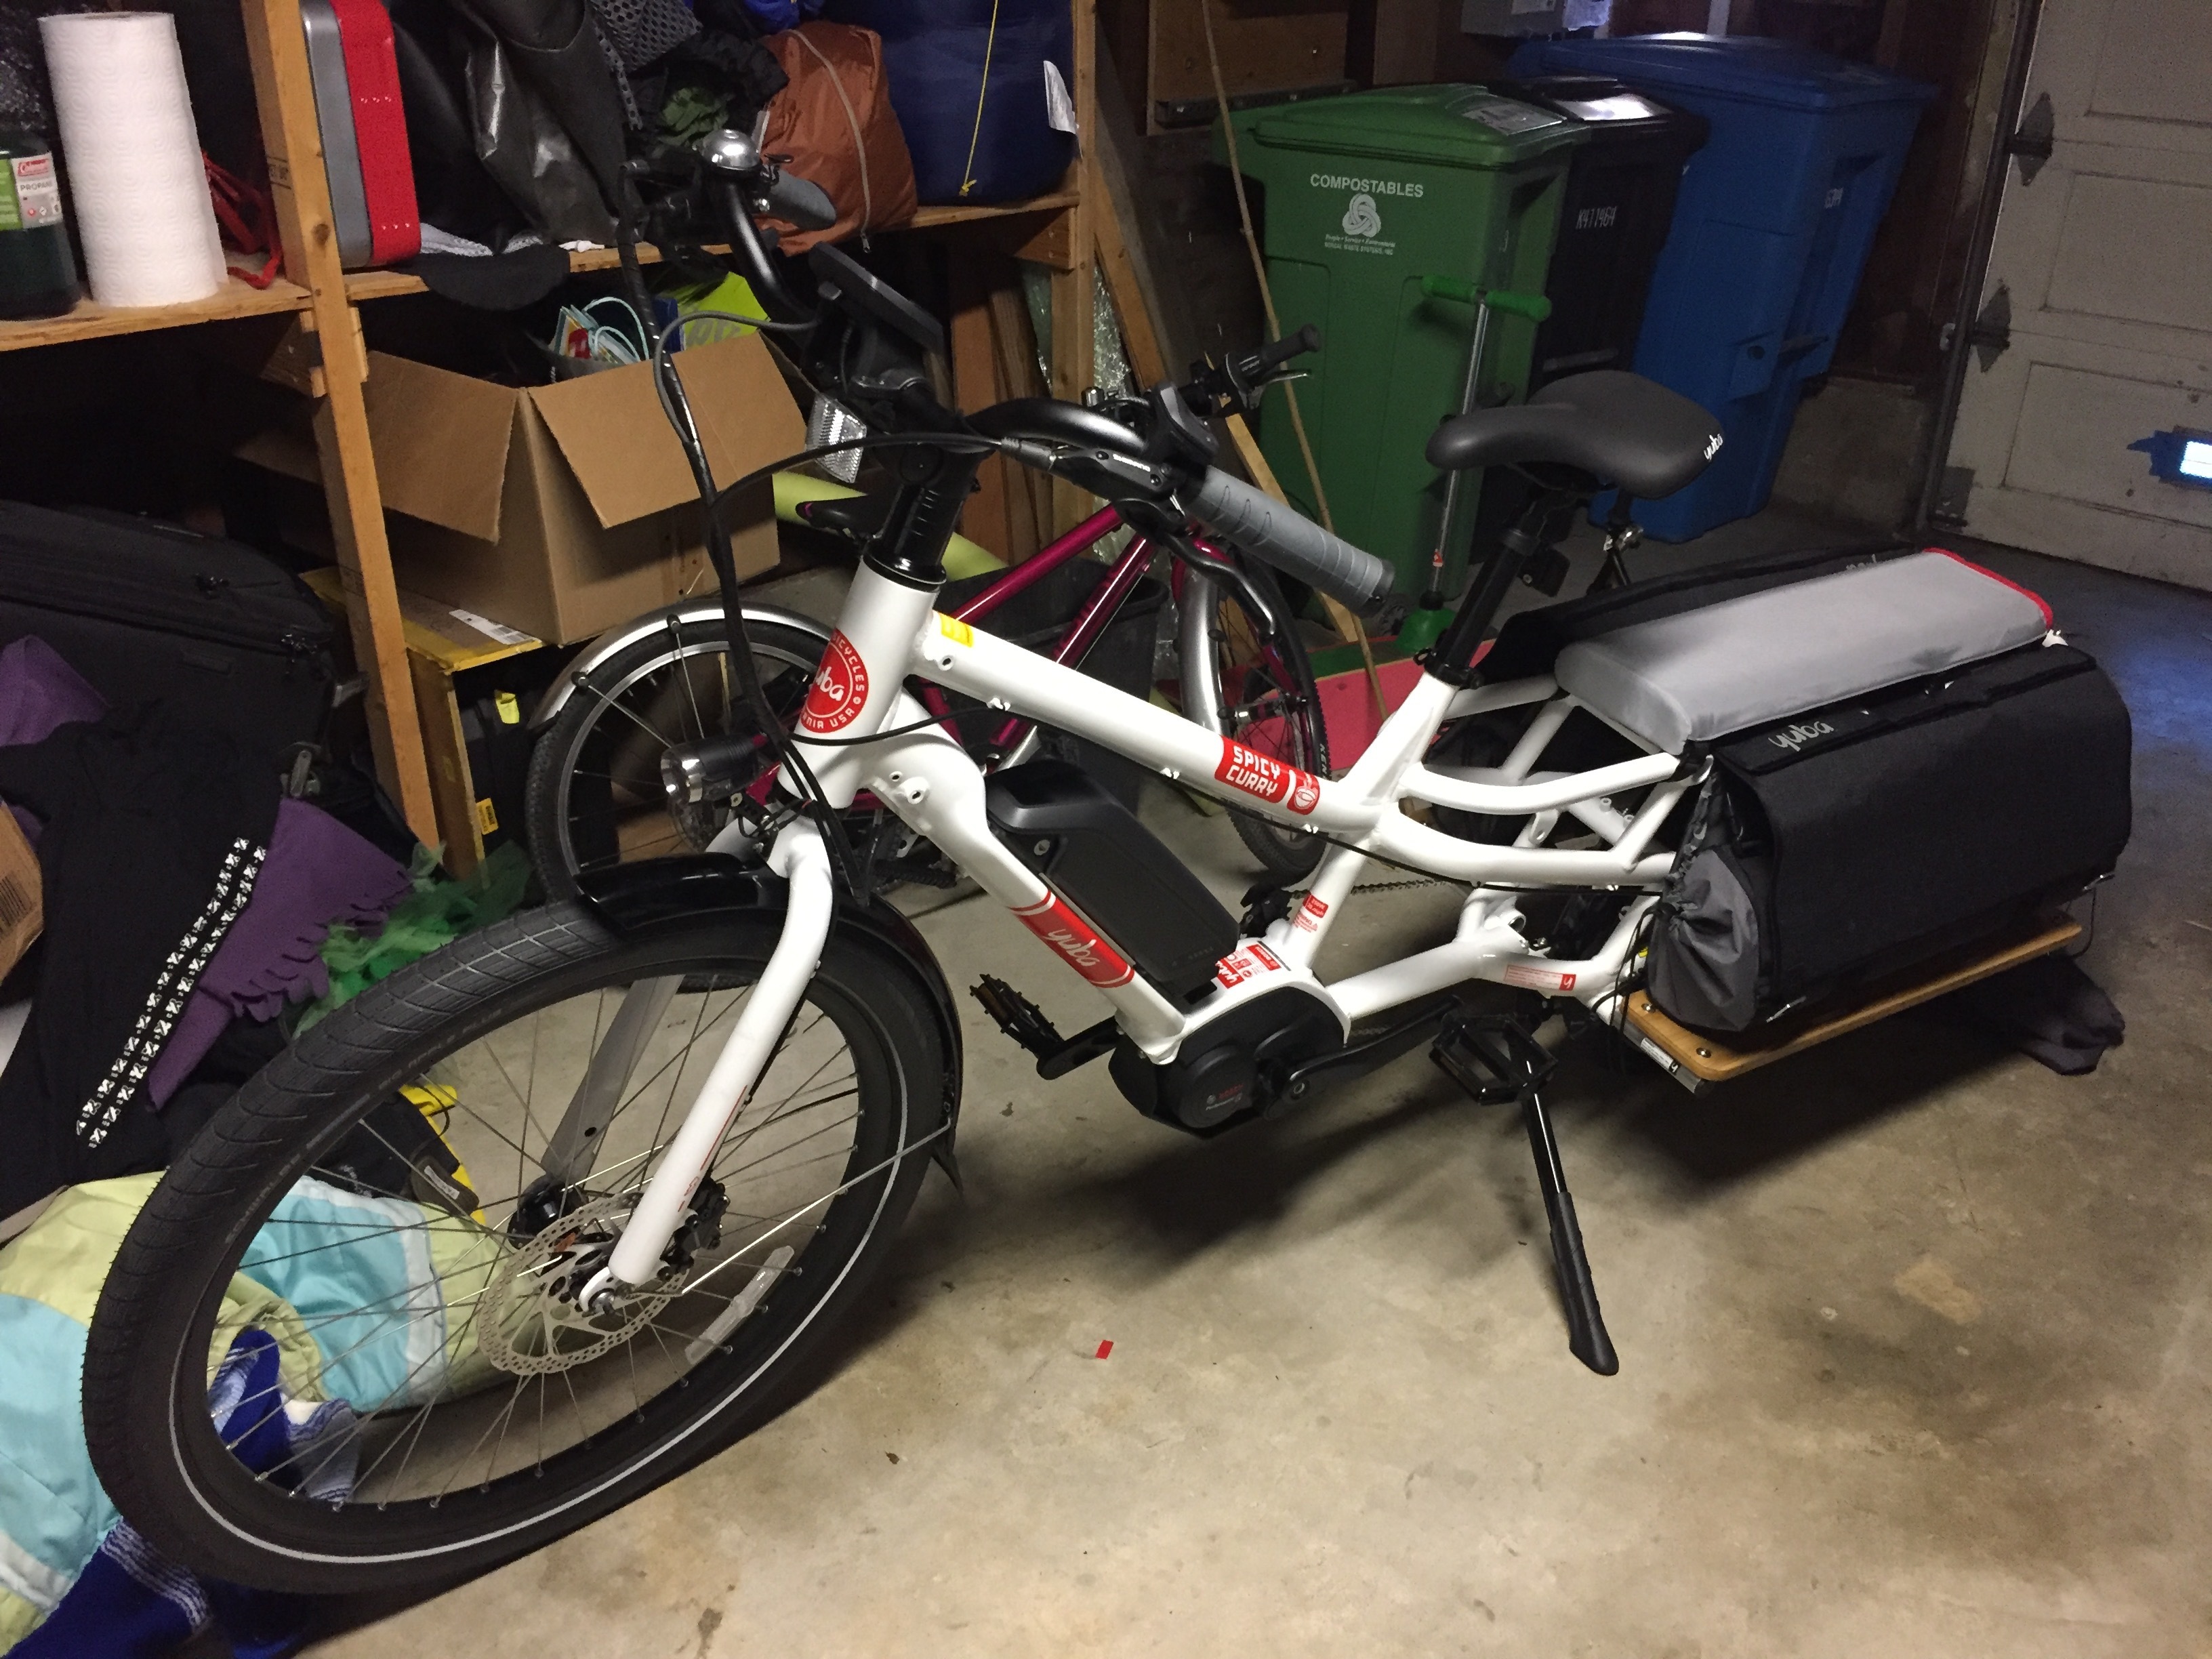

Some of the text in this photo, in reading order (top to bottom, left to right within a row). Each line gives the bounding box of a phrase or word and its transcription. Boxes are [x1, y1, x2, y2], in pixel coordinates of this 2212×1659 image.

[1309, 173, 1424, 198] COMPOSTABLES
[1703, 433, 1723, 462] yuba
[829, 707, 855, 728] USA
[1767, 720, 1835, 752] yuba
[1233, 745, 1281, 780] SPICY
[1225, 764, 1279, 797] CURRY
[1043, 928, 1101, 968] yuba
